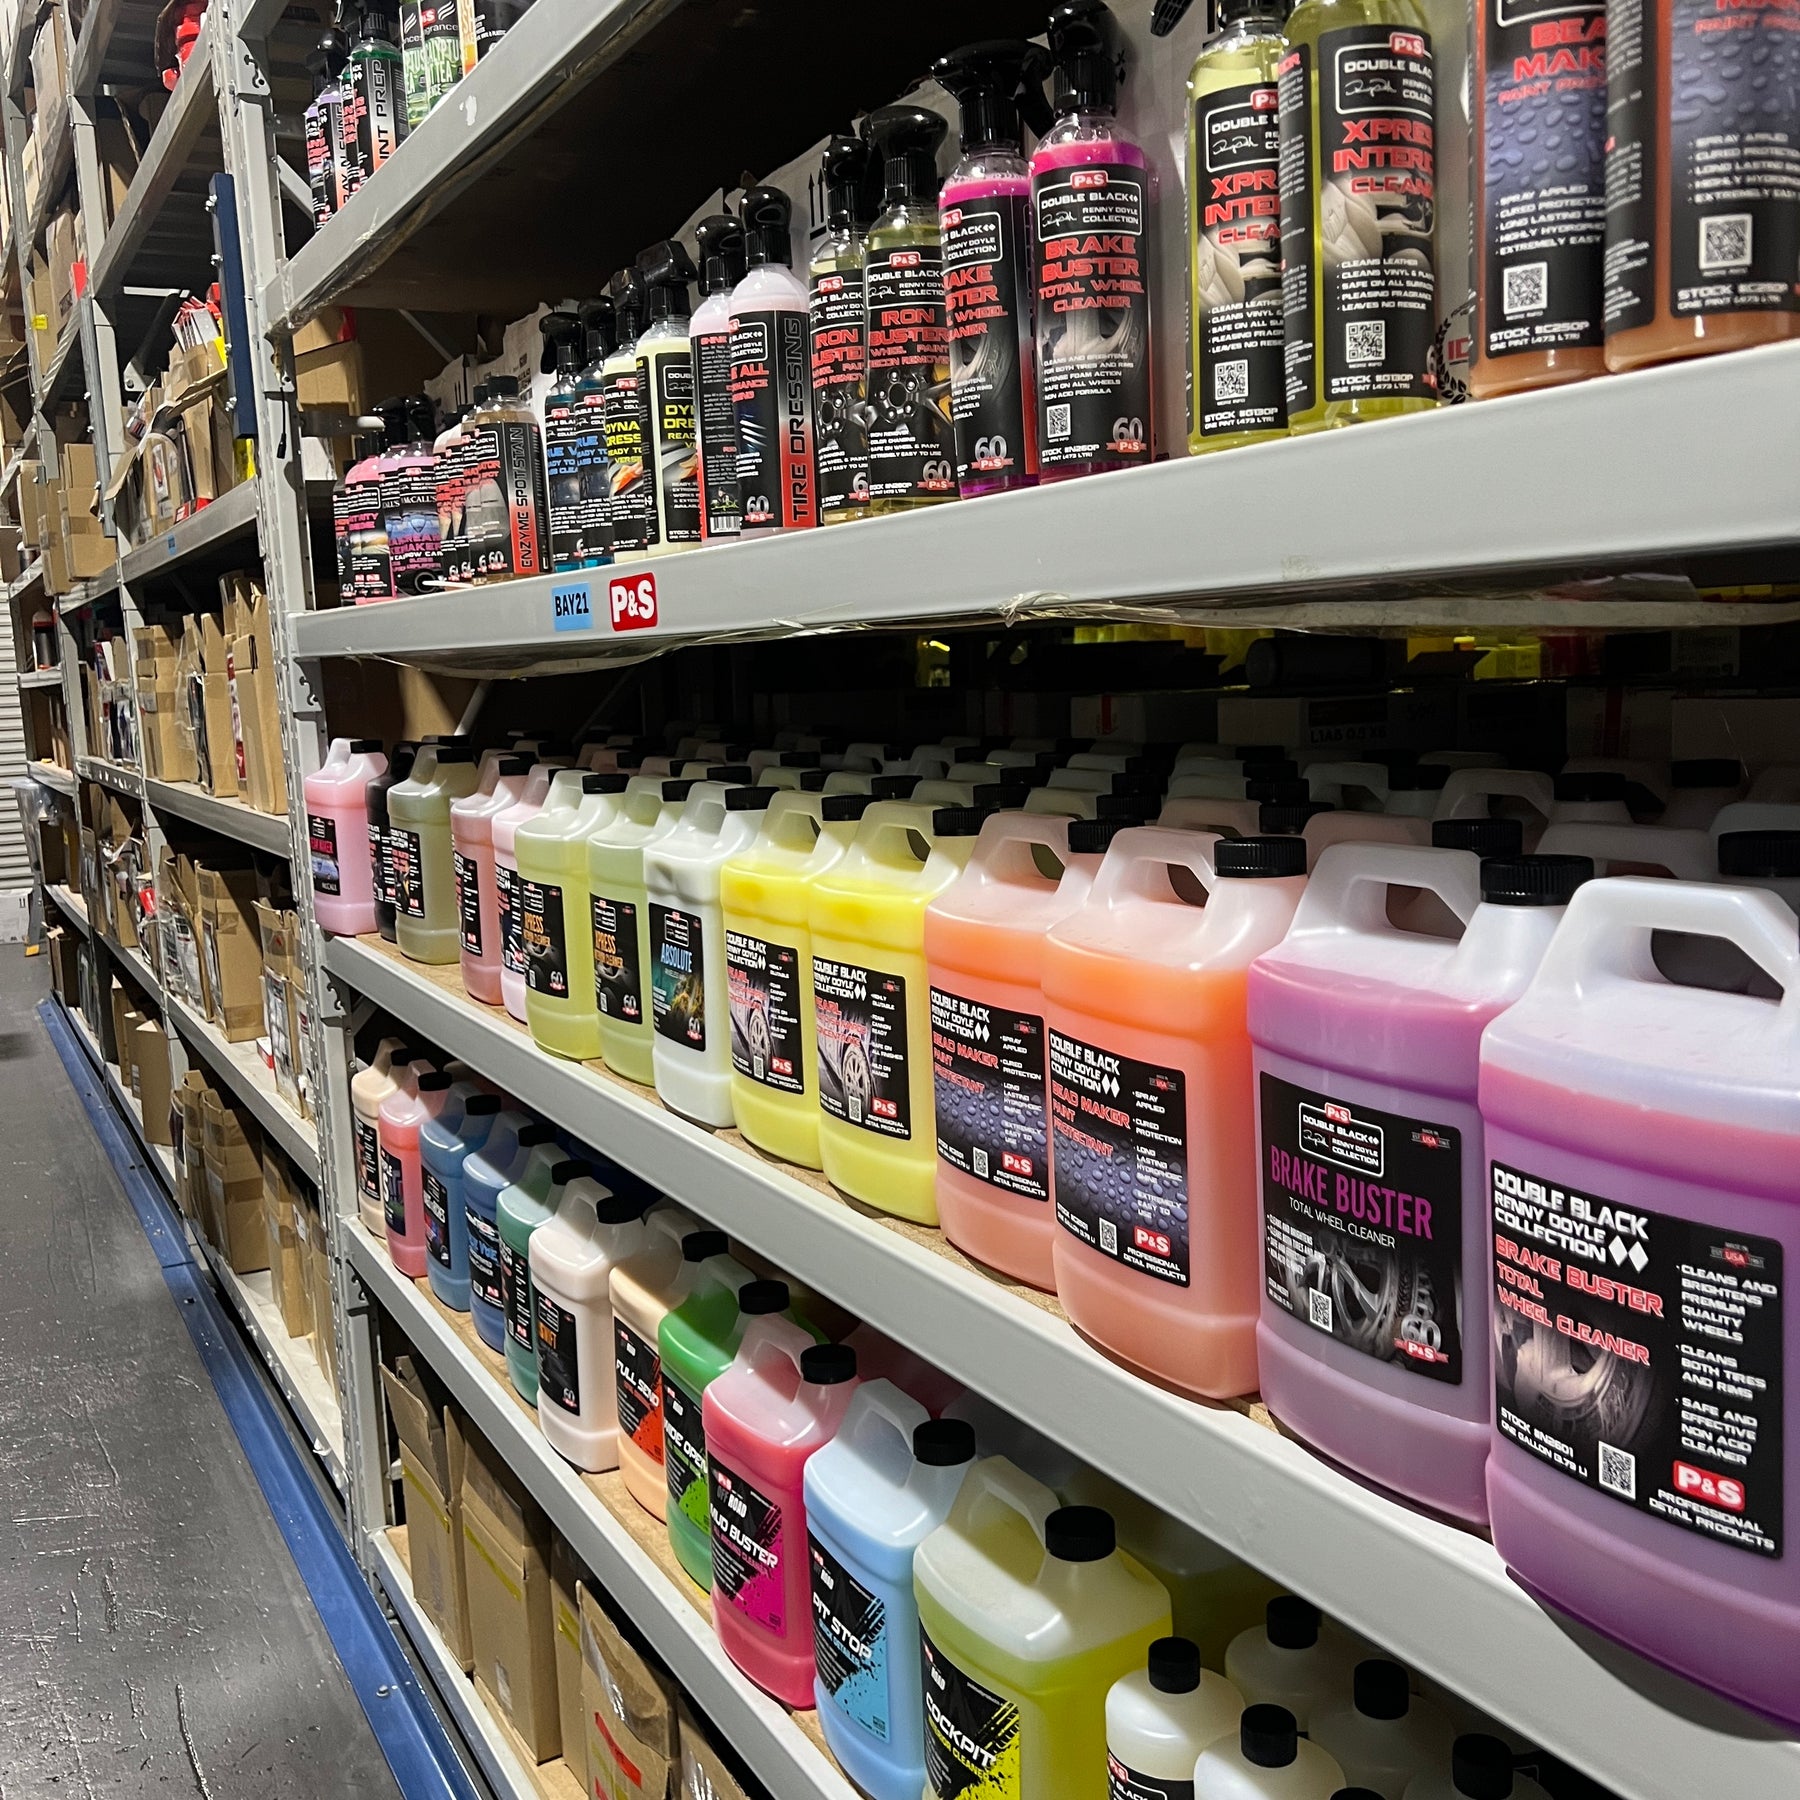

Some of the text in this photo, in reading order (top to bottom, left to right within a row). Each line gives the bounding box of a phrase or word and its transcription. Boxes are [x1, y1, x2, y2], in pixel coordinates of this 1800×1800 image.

[1395, 38, 1423, 54] P&S
[1344, 60, 1406, 74] DOUBLE
[371, 59, 386, 117] PREP
[1211, 115, 1269, 135] DOUBLE
[1074, 174, 1106, 188] P&S
[1041, 192, 1128, 209] DOUBLE BLACK
[1082, 206, 1139, 216] RENNY DOYLE
[1082, 214, 1139, 224] COLLECTION
[969, 237, 996, 247] DOYLE
[1045, 235, 1137, 260] BRAKE
[892, 254, 918, 267] P&S
[1041, 257, 1140, 283] BUSTER
[1341, 258, 1381, 268] CLEANS
[820, 279, 842, 291] P&S
[899, 282, 925, 290] RENNY
[904, 270, 941, 280] BLACK
[1341, 269, 1409, 280] CLEANS VINYL
[1342, 280, 1368, 290] SAFE
[829, 291, 863, 303] BLACK
[1038, 279, 1145, 301] TOTAL WHEEL
[1677, 285, 1734, 300] STOCK
[955, 306, 1008, 322] WHEEL
[1053, 296, 1132, 313] CLEANER
[881, 308, 936, 327] IRON
[1490, 327, 1531, 342] STOCK
[740, 363, 770, 378] ALL
[1094, 370, 1123, 378] ACTION
[1331, 375, 1371, 387] STOCK
[1072, 379, 1121, 388] ALL WHEELS
[605, 420, 640, 434] DYNA
[663, 418, 696, 430] DRE
[784, 317, 809, 522] TIRE DRESSING
[606, 433, 642, 448] DRESS
[1119, 441, 1140, 452] P&S
[980, 458, 1002, 469] P&S
[520, 511, 533, 568] ENZYME
[554, 591, 590, 617] BAY21
[610, 579, 655, 623] P&S
[660, 942, 693, 973] ABSOLUTE
[831, 975, 854, 989] DOYLE
[840, 964, 868, 983] BLACK
[931, 990, 990, 1023] DOUBLE BLACK
[931, 1014, 975, 1040] COLLECTION
[951, 1012, 974, 1028] DOYLE
[772, 1059, 792, 1074] P&S
[957, 1042, 1000, 1070] MAKER
[1050, 1033, 1120, 1076] DOUBLE BLACK
[1050, 1048, 1101, 1081] RENNY DOYLE
[1002, 1066, 1042, 1081] PROTECTION
[1050, 1060, 1102, 1094] COLLECTION
[873, 1099, 897, 1116] P&S
[1052, 1079, 1131, 1130] BEAD MAKER
[1327, 1106, 1349, 1122] P&S
[1135, 1127, 1183, 1146] PROTECTION
[1303, 1114, 1370, 1144] DOUBLE BLACK
[1003, 1154, 1032, 1174] P&S
[1331, 1145, 1379, 1167] COLLECTION
[1270, 1144, 1434, 1240] BRAKE BUSTER
[1494, 1167, 1650, 1240] DOUBLE BLACK
[1289, 1196, 1314, 1219] TOTAL
[1315, 1208, 1347, 1233] WHEEL
[1347, 1222, 1397, 1250] CLEANER
[1494, 1190, 1606, 1244] RENNY DOYLE
[1136, 1228, 1170, 1253] P&S
[1494, 1206, 1606, 1264] COLLECTION
[1127, 1246, 1181, 1272] PROFESSIONAL
[1146, 1262, 1187, 1282] PRODUCTS
[1495, 1234, 1665, 1319] BRAKE BUSTER
[1496, 1260, 1545, 1299] TOTAL
[1681, 1263, 1778, 1298] CLEANS AND
[1681, 1277, 1763, 1308] BRIGHTENS
[1496, 1283, 1651, 1367] WHEEL CLEANER
[1681, 1304, 1743, 1329] QUALITY
[539, 1324, 557, 1350] SWIFT
[1681, 1318, 1744, 1345] WHEELS
[1407, 1342, 1434, 1360] P&S
[1680, 1344, 1738, 1368] CLEANS
[616, 1358, 660, 1408] FULL SEND
[1681, 1357, 1767, 1391] BOTH TIRES
[1681, 1371, 1753, 1400] AND RIMS
[1501, 1406, 1531, 1435] STOCK
[1681, 1396, 1758, 1427] SAFE AND
[1681, 1410, 1757, 1442] EFFECTIVE
[1681, 1423, 1752, 1454] NON ACID
[1517, 1431, 1553, 1459] GALLON
[1681, 1436, 1748, 1466] CLEANER
[1677, 1466, 1742, 1506] P&S
[728, 1494, 747, 1519] ROAD
[1658, 1488, 1764, 1534] PROFESSIONAL
[1649, 1496, 1775, 1551] DETAIL PRODUCTS
[729, 1525, 779, 1570] BUSTER
[812, 1591, 831, 1620] PIT
[830, 1615, 873, 1660] STOP
[926, 1691, 997, 1768] COCKPIT
[952, 1747, 990, 1780] CLEANER
